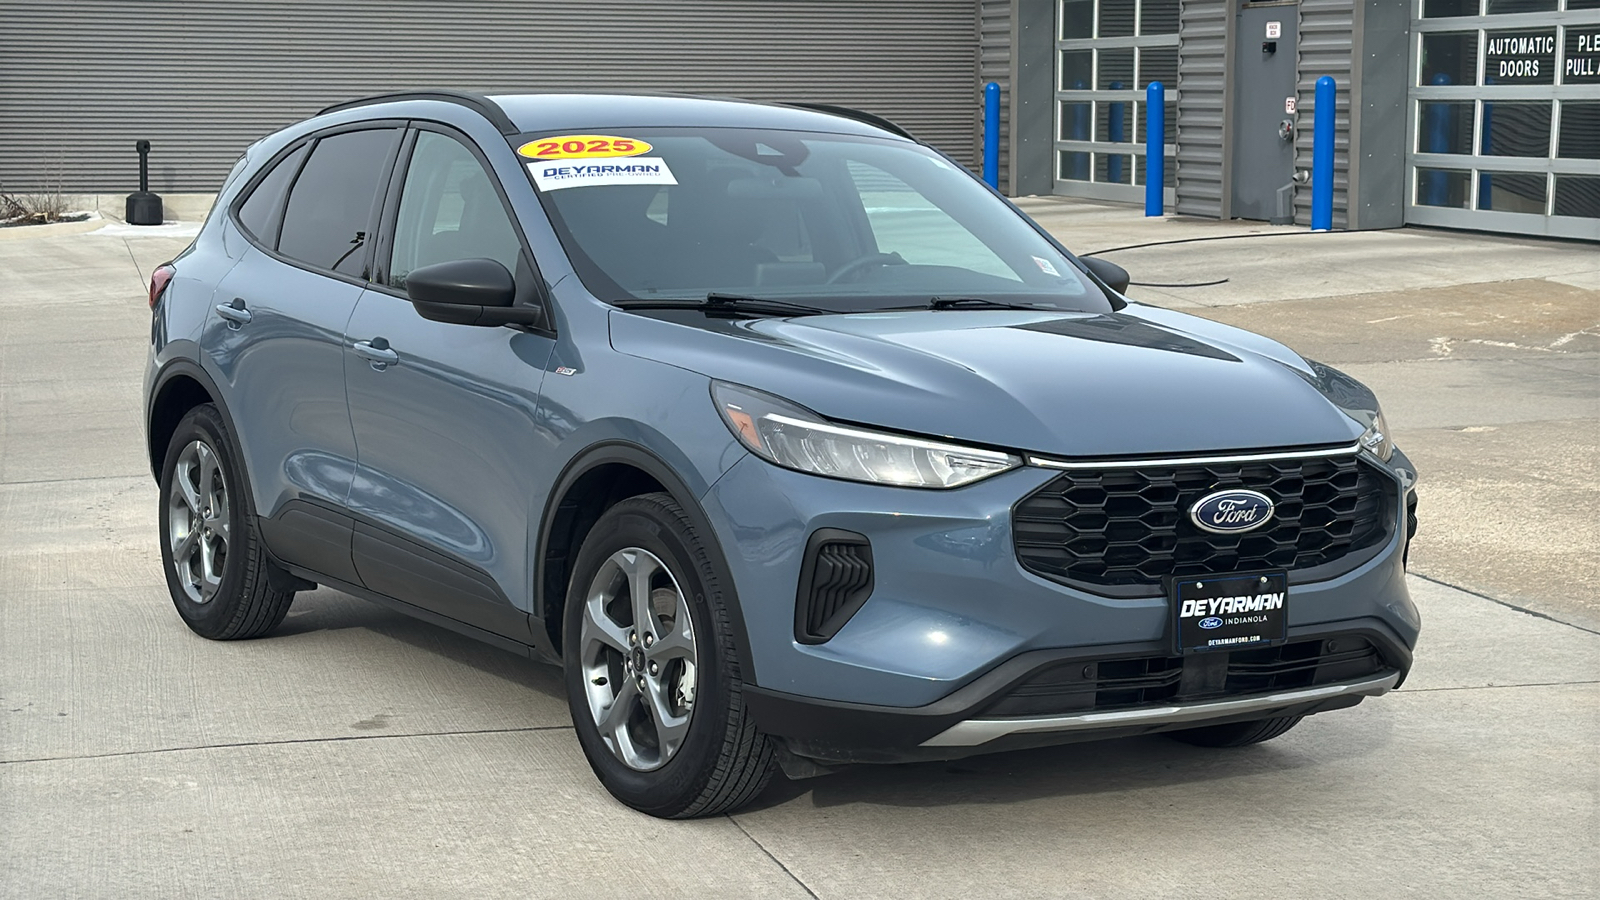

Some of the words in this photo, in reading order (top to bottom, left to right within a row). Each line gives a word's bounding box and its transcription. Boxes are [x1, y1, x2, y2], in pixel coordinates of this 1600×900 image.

[1488, 36, 1554, 55] AUTOMATIC
[1500, 60, 1539, 77] DOORS
[1566, 58, 1594, 76] PULL
[537, 140, 636, 156] 2025
[543, 165, 660, 177] DEYARMAN
[1213, 499, 1258, 524] Ford
[1180, 592, 1284, 618] DEYARMAN
[1225, 615, 1268, 625] INDIANOLA
[1208, 635, 1261, 646] DEYARMANFORD.COM
